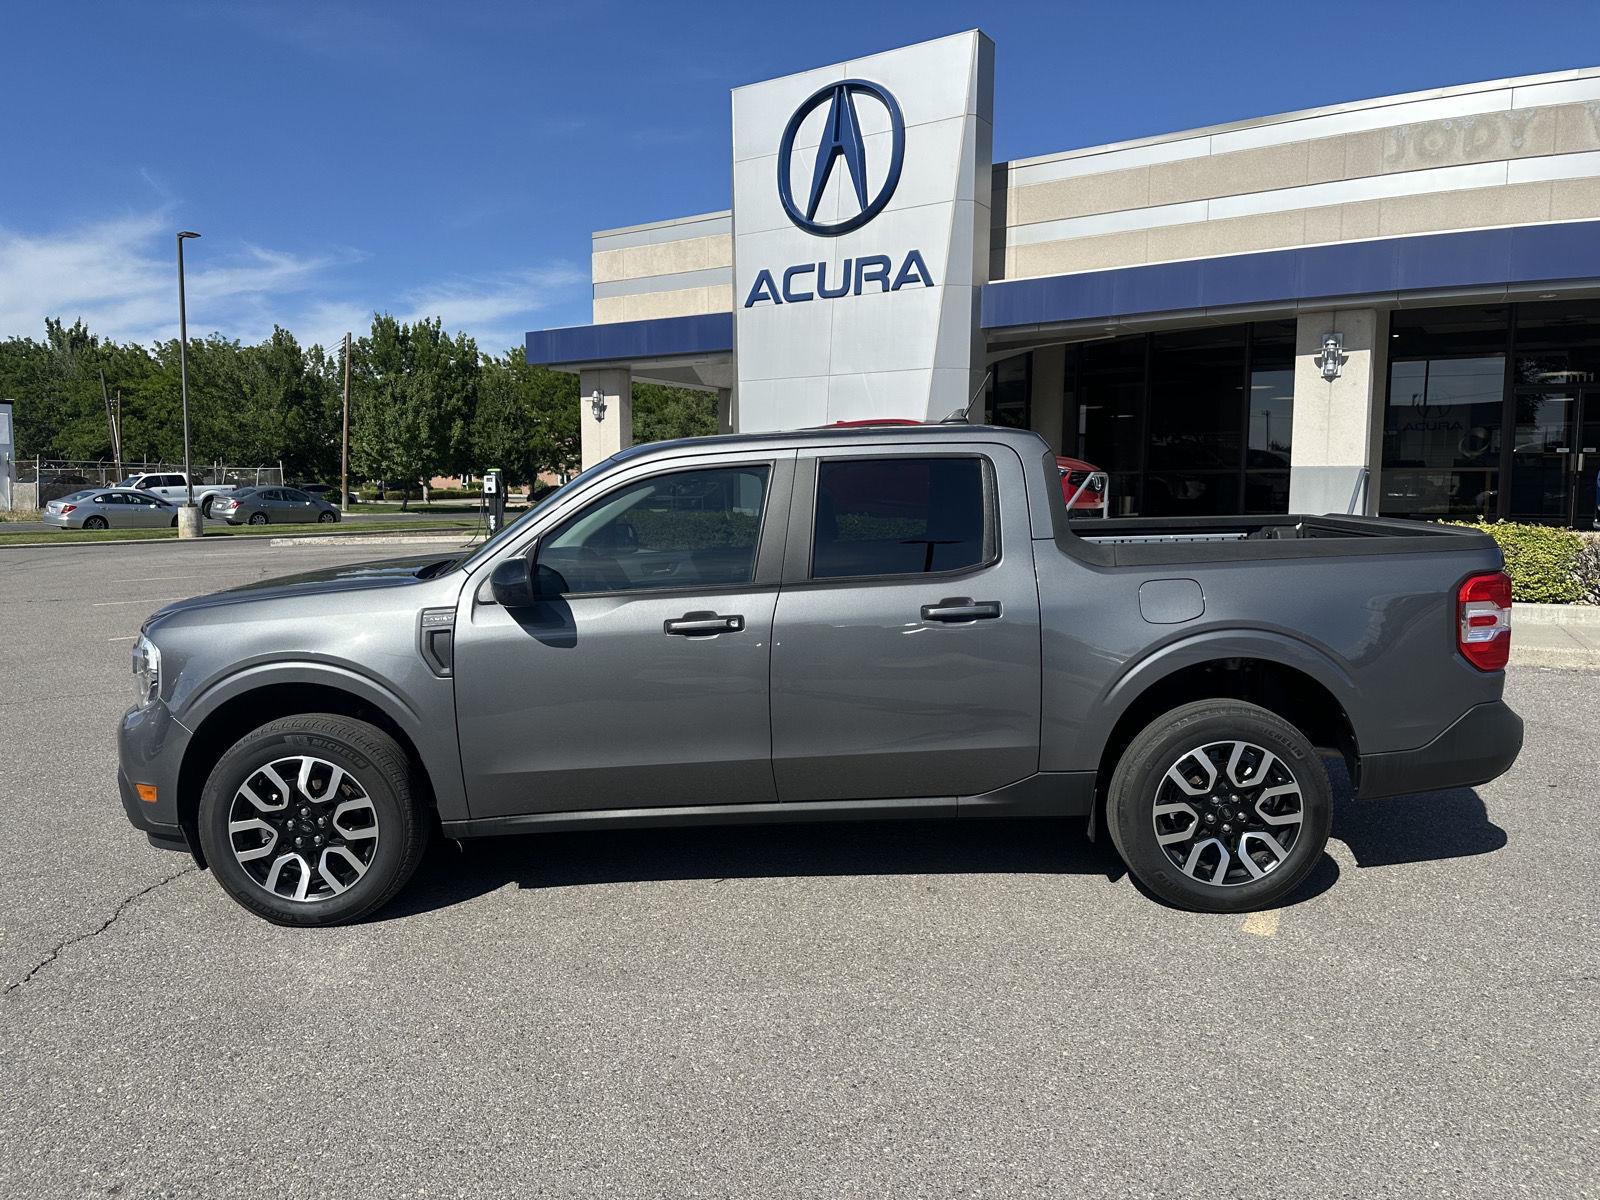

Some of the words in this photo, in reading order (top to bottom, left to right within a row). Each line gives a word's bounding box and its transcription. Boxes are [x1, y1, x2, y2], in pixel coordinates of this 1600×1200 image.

[744, 249, 935, 308] ACURA
[1402, 421, 1464, 432] ACURA
[310, 738, 369, 769] MICHELIN
